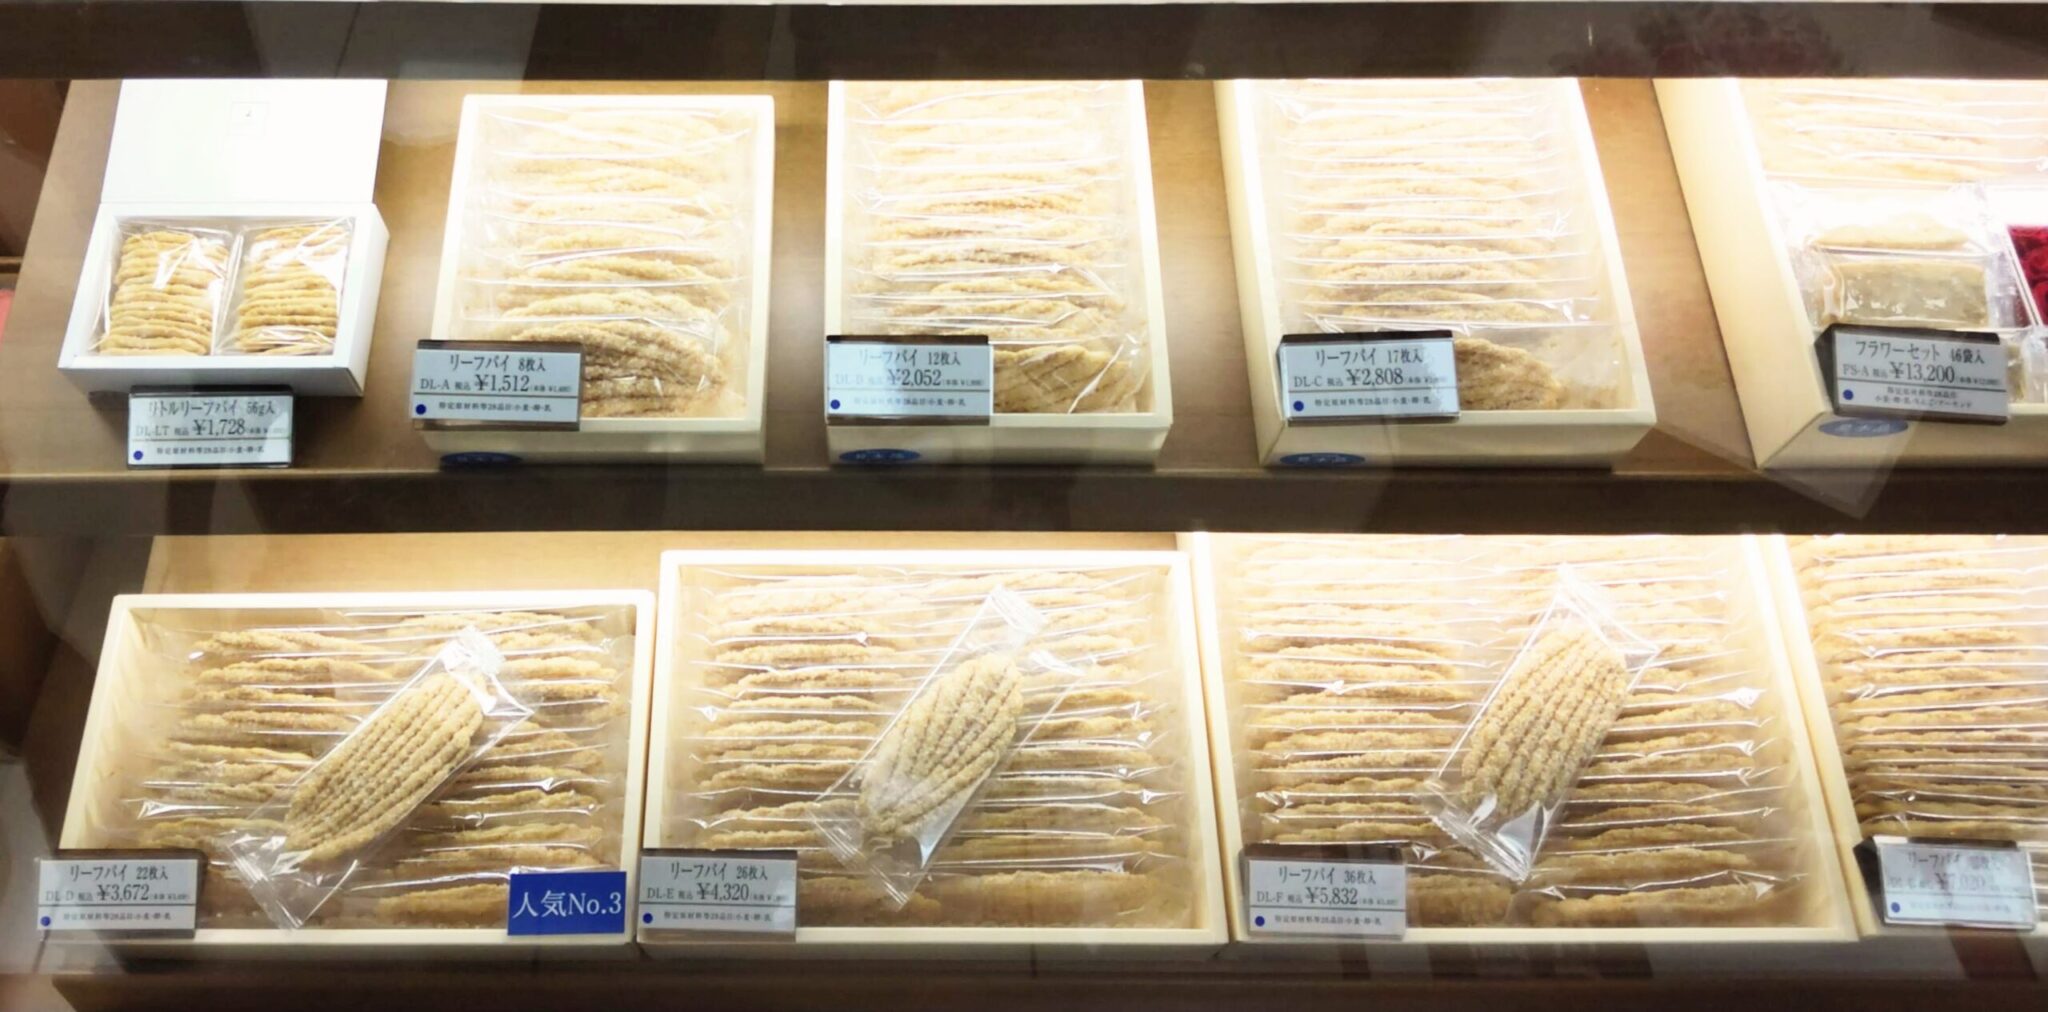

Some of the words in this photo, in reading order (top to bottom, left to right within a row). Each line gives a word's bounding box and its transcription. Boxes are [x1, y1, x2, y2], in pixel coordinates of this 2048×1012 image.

[928, 352, 961, 366] 12枚入
[1387, 349, 1423, 364] 17枚入
[1855, 340, 1941, 361] フラワーセット
[518, 358, 546, 372] 8枚入
[1889, 362, 1956, 384] ¥13,200
[420, 378, 450, 390] DL-A
[474, 374, 530, 392] ¥1,512
[887, 369, 942, 387] ¥2,052
[1294, 376, 1322, 388] DL-C
[1345, 368, 1404, 387] ¥2,808
[193, 419, 245, 436] ¥1,728
[97, 884, 149, 901] ¥3,672
[647, 888, 674, 899] DL-E
[696, 883, 749, 901] ¥4,320
[1256, 891, 1284, 902] DL-F
[1305, 887, 1358, 905] ¥5,832
[511, 890, 622, 918] 人気No.3
